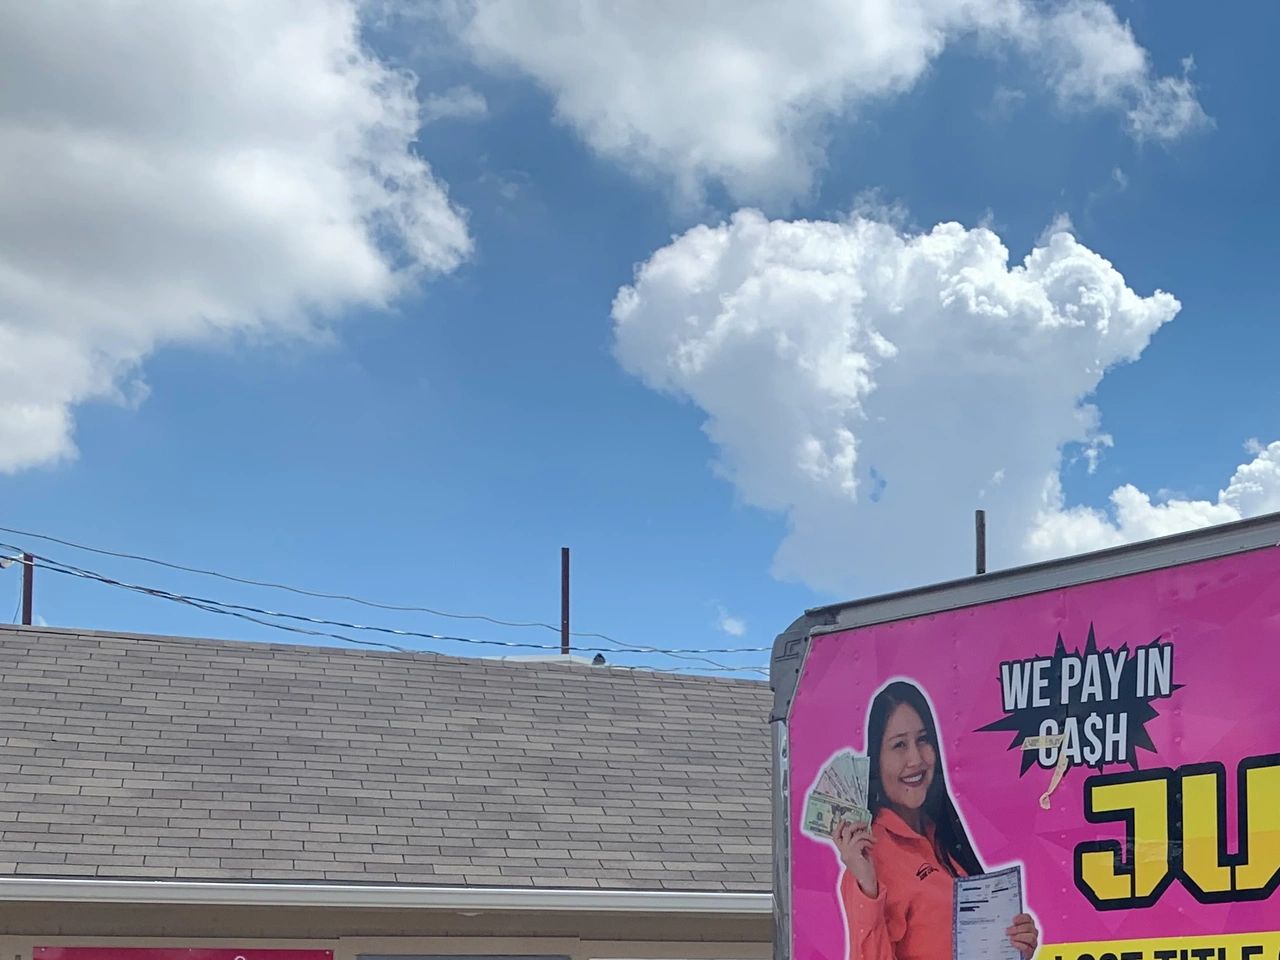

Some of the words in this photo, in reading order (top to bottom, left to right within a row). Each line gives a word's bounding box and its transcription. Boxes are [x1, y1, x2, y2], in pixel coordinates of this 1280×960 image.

[1001, 661, 1052, 710] WE
[1061, 652, 1127, 705] PAY
[1136, 644, 1173, 699] IN
